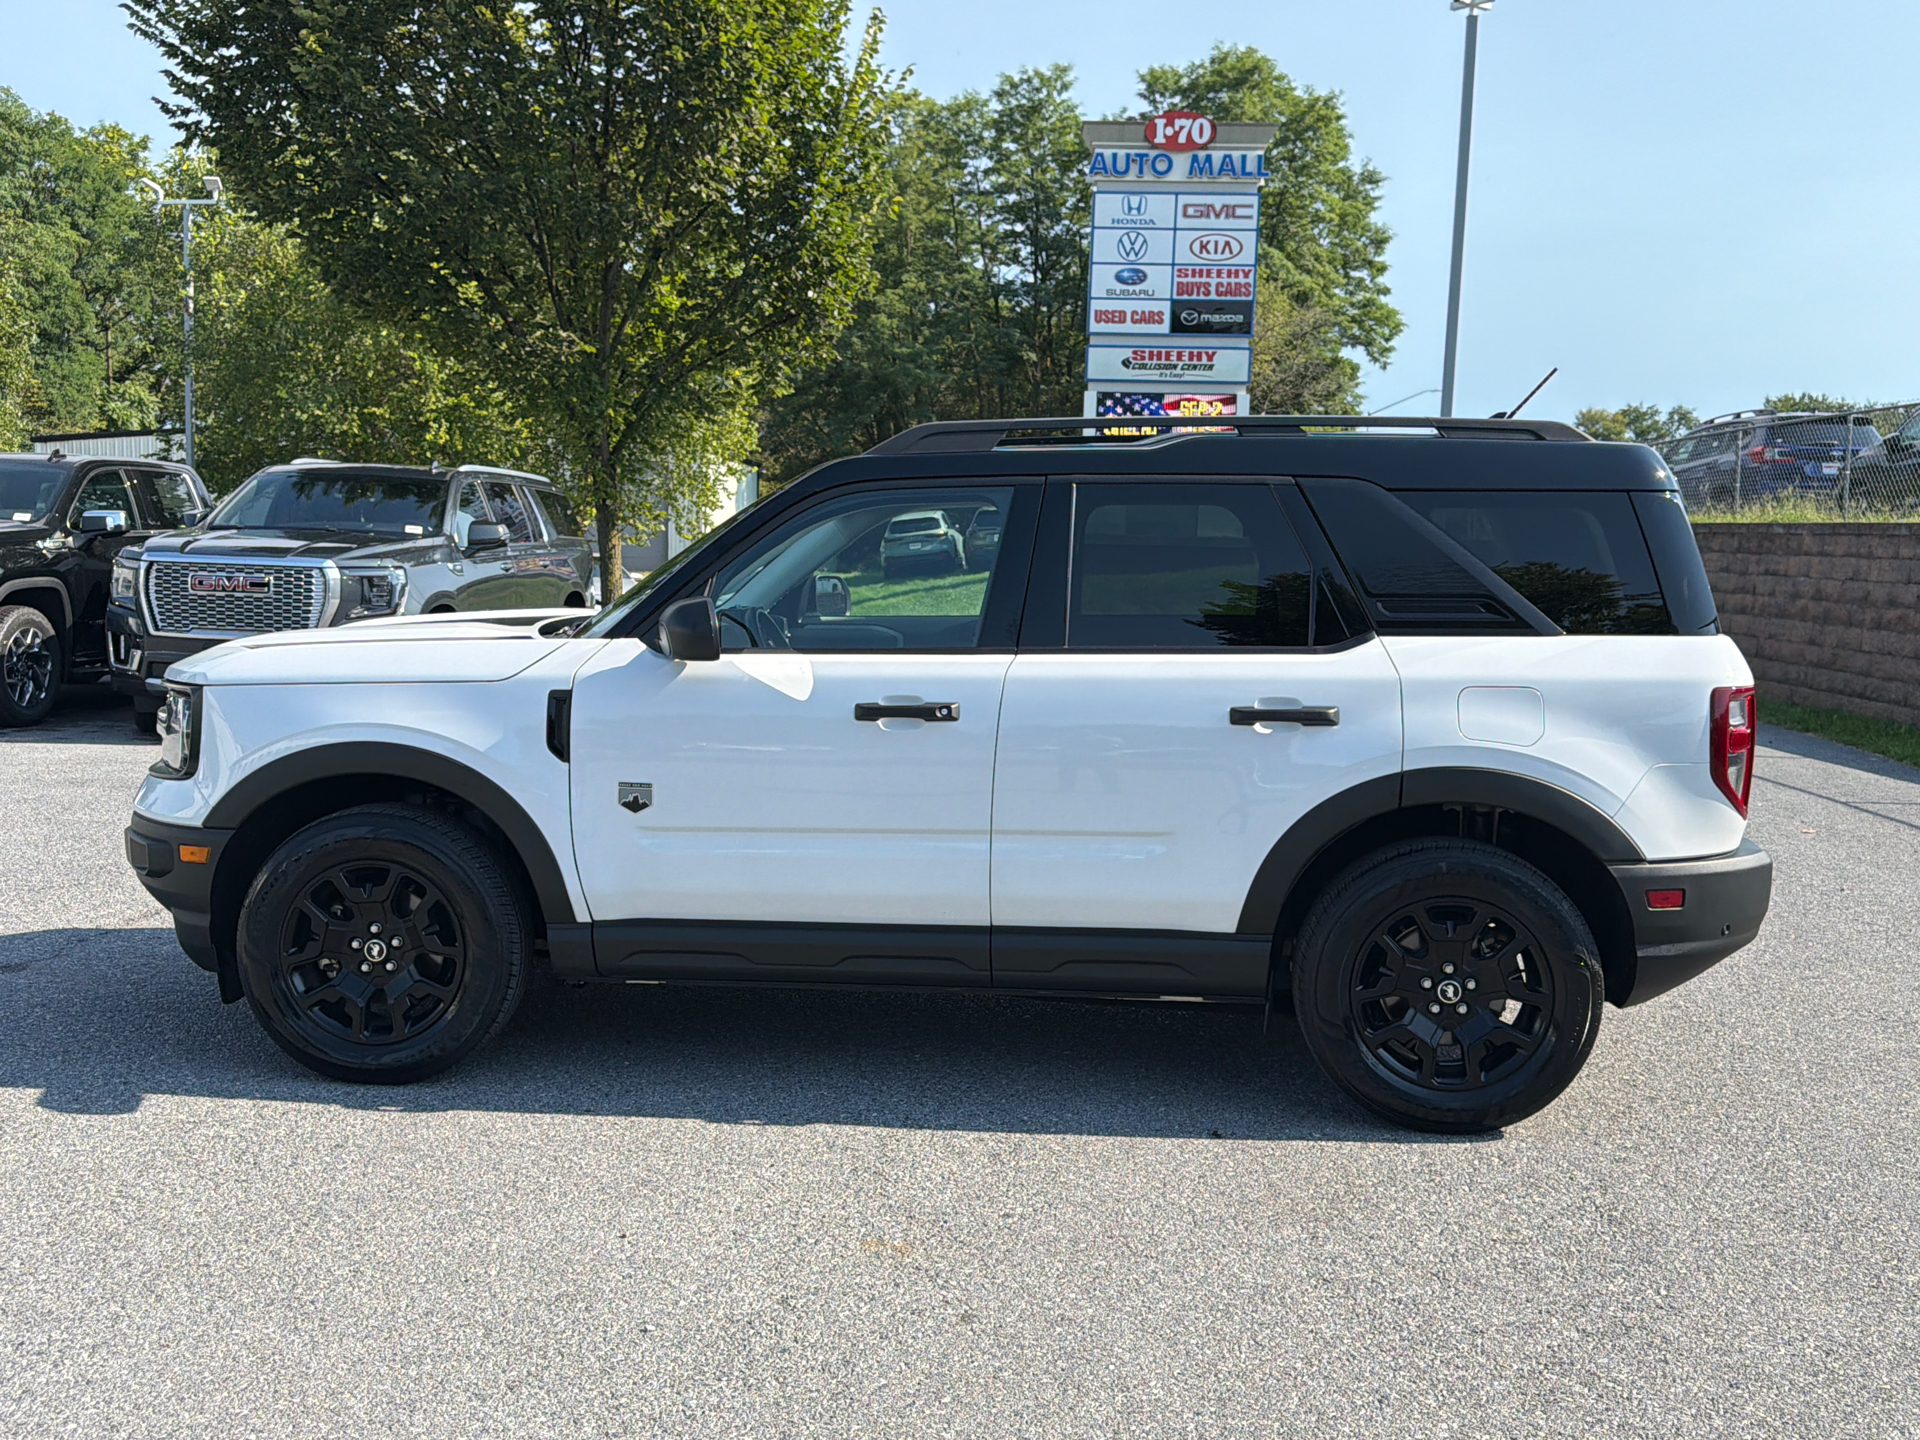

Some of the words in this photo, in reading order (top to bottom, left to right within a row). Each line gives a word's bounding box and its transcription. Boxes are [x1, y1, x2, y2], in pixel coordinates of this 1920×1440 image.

[1088, 152, 1174, 177] AUTO
[1188, 153, 1270, 178] MALL
[1182, 203, 1254, 220] GMC
[1111, 218, 1156, 226] HONDA
[1199, 240, 1234, 256] KIA
[1176, 268, 1253, 279] SHEEHY
[1106, 289, 1155, 297] SUBARU
[1176, 282, 1211, 297] BUYS
[1215, 282, 1252, 298] CARS
[1094, 309, 1127, 324] USED
[1130, 310, 1164, 325] CARS
[1200, 314, 1244, 323] mazda
[1131, 350, 1218, 362] SHEEHY
[1131, 362, 1178, 371] COLLISION
[1180, 363, 1215, 371] CENTER
[1158, 371, 1168, 379] It's
[192, 576, 269, 592] GMC
